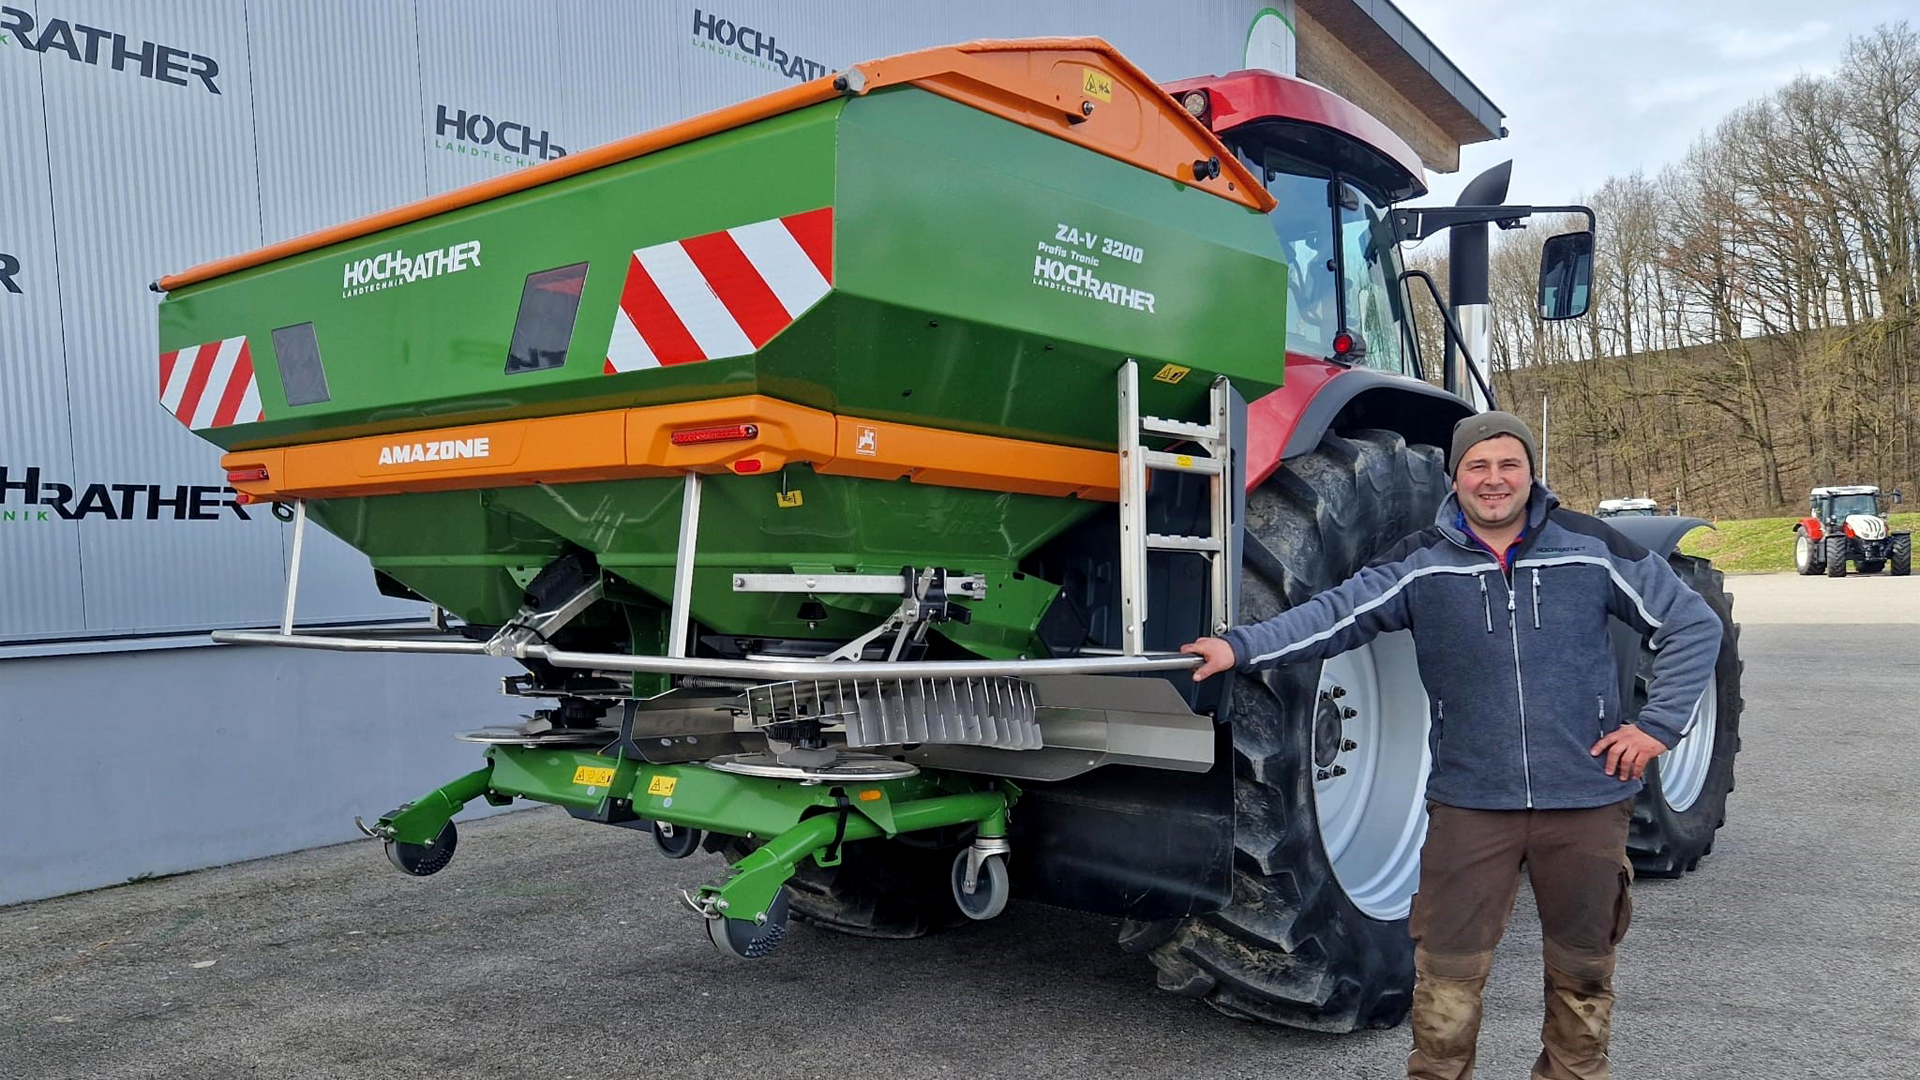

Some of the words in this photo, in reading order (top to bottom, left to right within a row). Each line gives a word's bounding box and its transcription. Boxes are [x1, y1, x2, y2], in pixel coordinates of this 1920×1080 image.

[1, 6, 222, 95] RATHER
[692, 38, 779, 72] LANDTECHNIK
[1037, 241, 1067, 258] Profis
[1070, 250, 1099, 267] Tronic
[1055, 223, 1098, 249] ZA-V
[1101, 238, 1144, 264] 3200
[343, 239, 481, 288] HOCHRATHER
[342, 277, 404, 299] LANDTECHNIK
[1032, 277, 1092, 298] LANDTECHNIK
[1034, 255, 1155, 314] HOCHRATHER
[379, 437, 489, 465] AMAZONE
[3, 511, 49, 521] NIK
